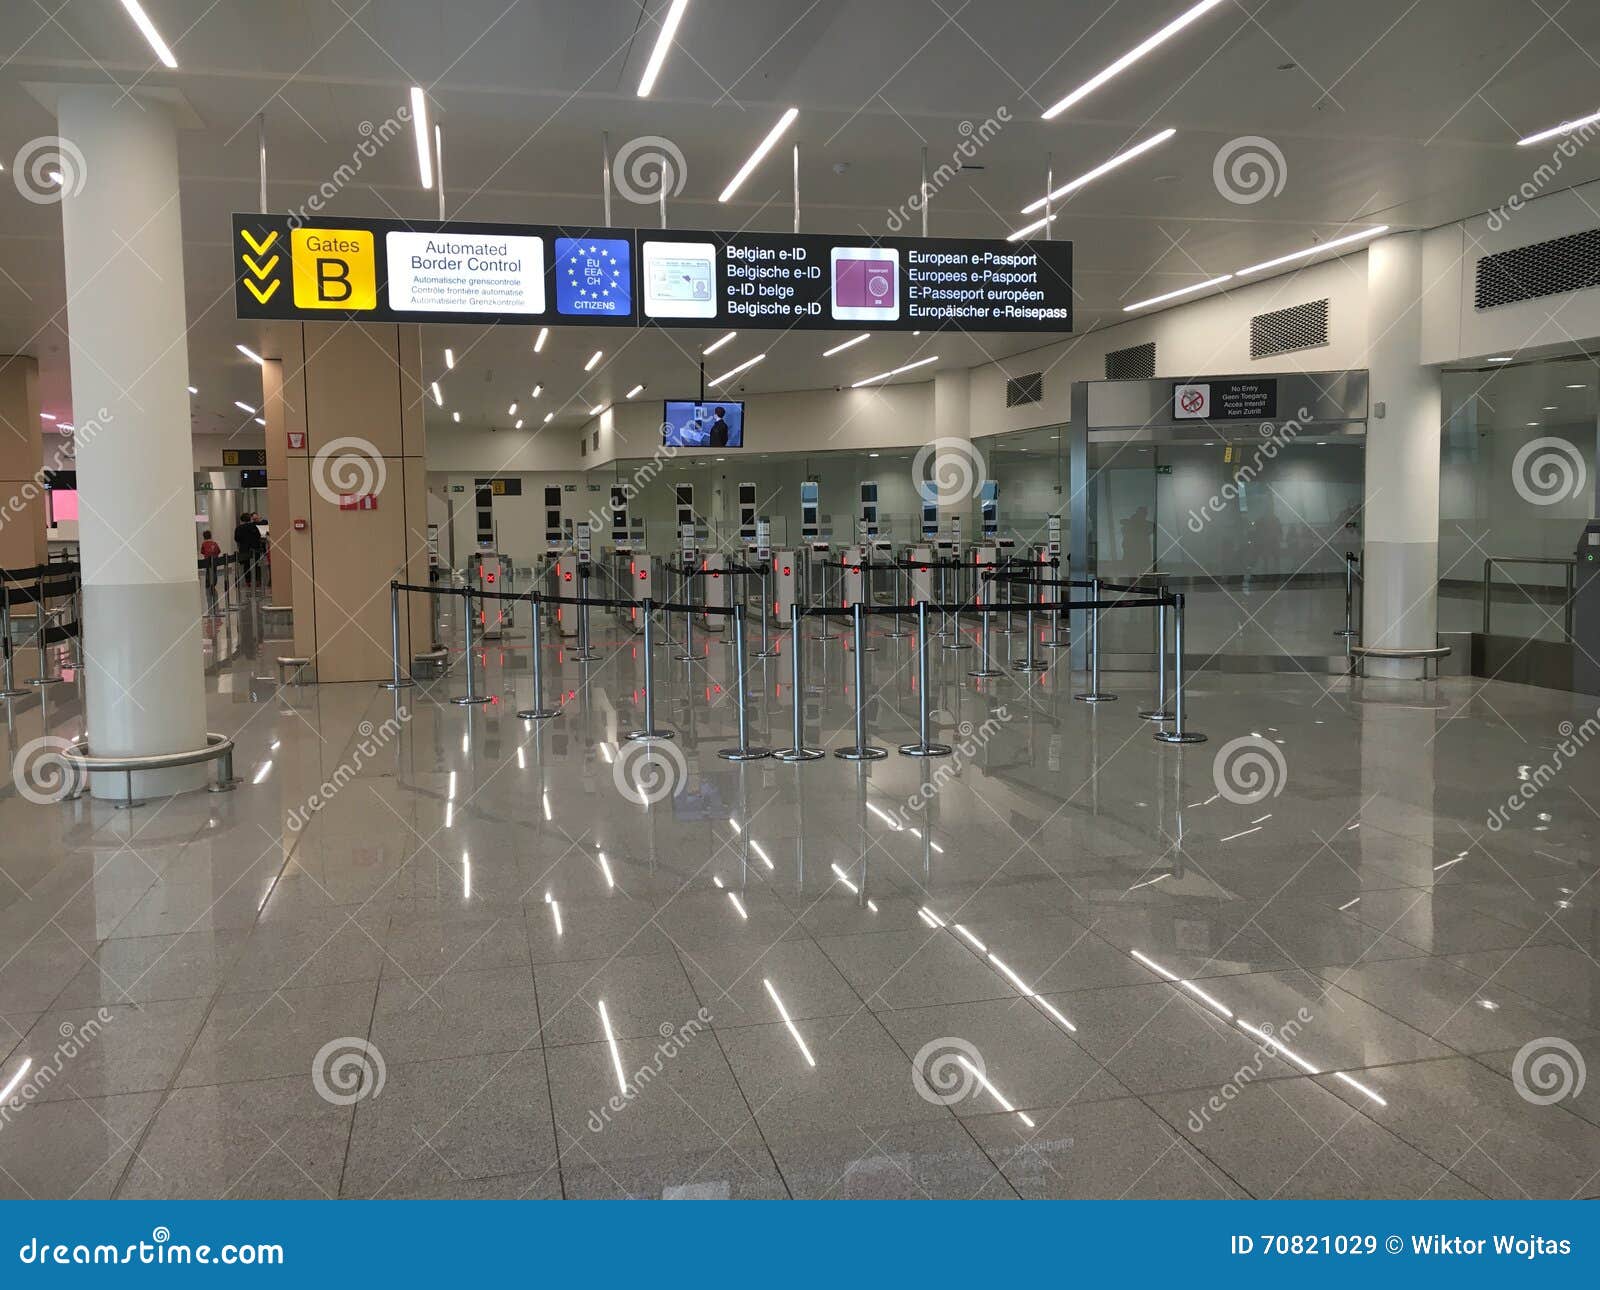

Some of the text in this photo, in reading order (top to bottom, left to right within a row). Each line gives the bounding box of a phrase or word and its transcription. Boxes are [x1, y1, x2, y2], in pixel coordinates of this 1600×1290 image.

[306, 236, 360, 254] Gates
[425, 240, 507, 256] Automated
[726, 246, 807, 262] Belgian e-ID
[908, 250, 1037, 268] European e-Passport
[411, 256, 521, 272] Border Control
[586, 258, 600, 268] EU
[317, 258, 353, 302] B
[413, 275, 467, 285] Automatische
[584, 268, 604, 277] EEA
[727, 264, 822, 281] Belgische e-ID
[909, 269, 1037, 285] Europees e-Paspoort
[586, 277, 601, 286] CH
[411, 286, 445, 295] Contrôle
[727, 283, 795, 300] e-ID belge
[909, 286, 1044, 303] E-Passeport européen
[574, 301, 616, 311] CITIZENS
[727, 301, 823, 318] Belgische e-ID
[909, 304, 1068, 321] Europäischer e-Reisepass
